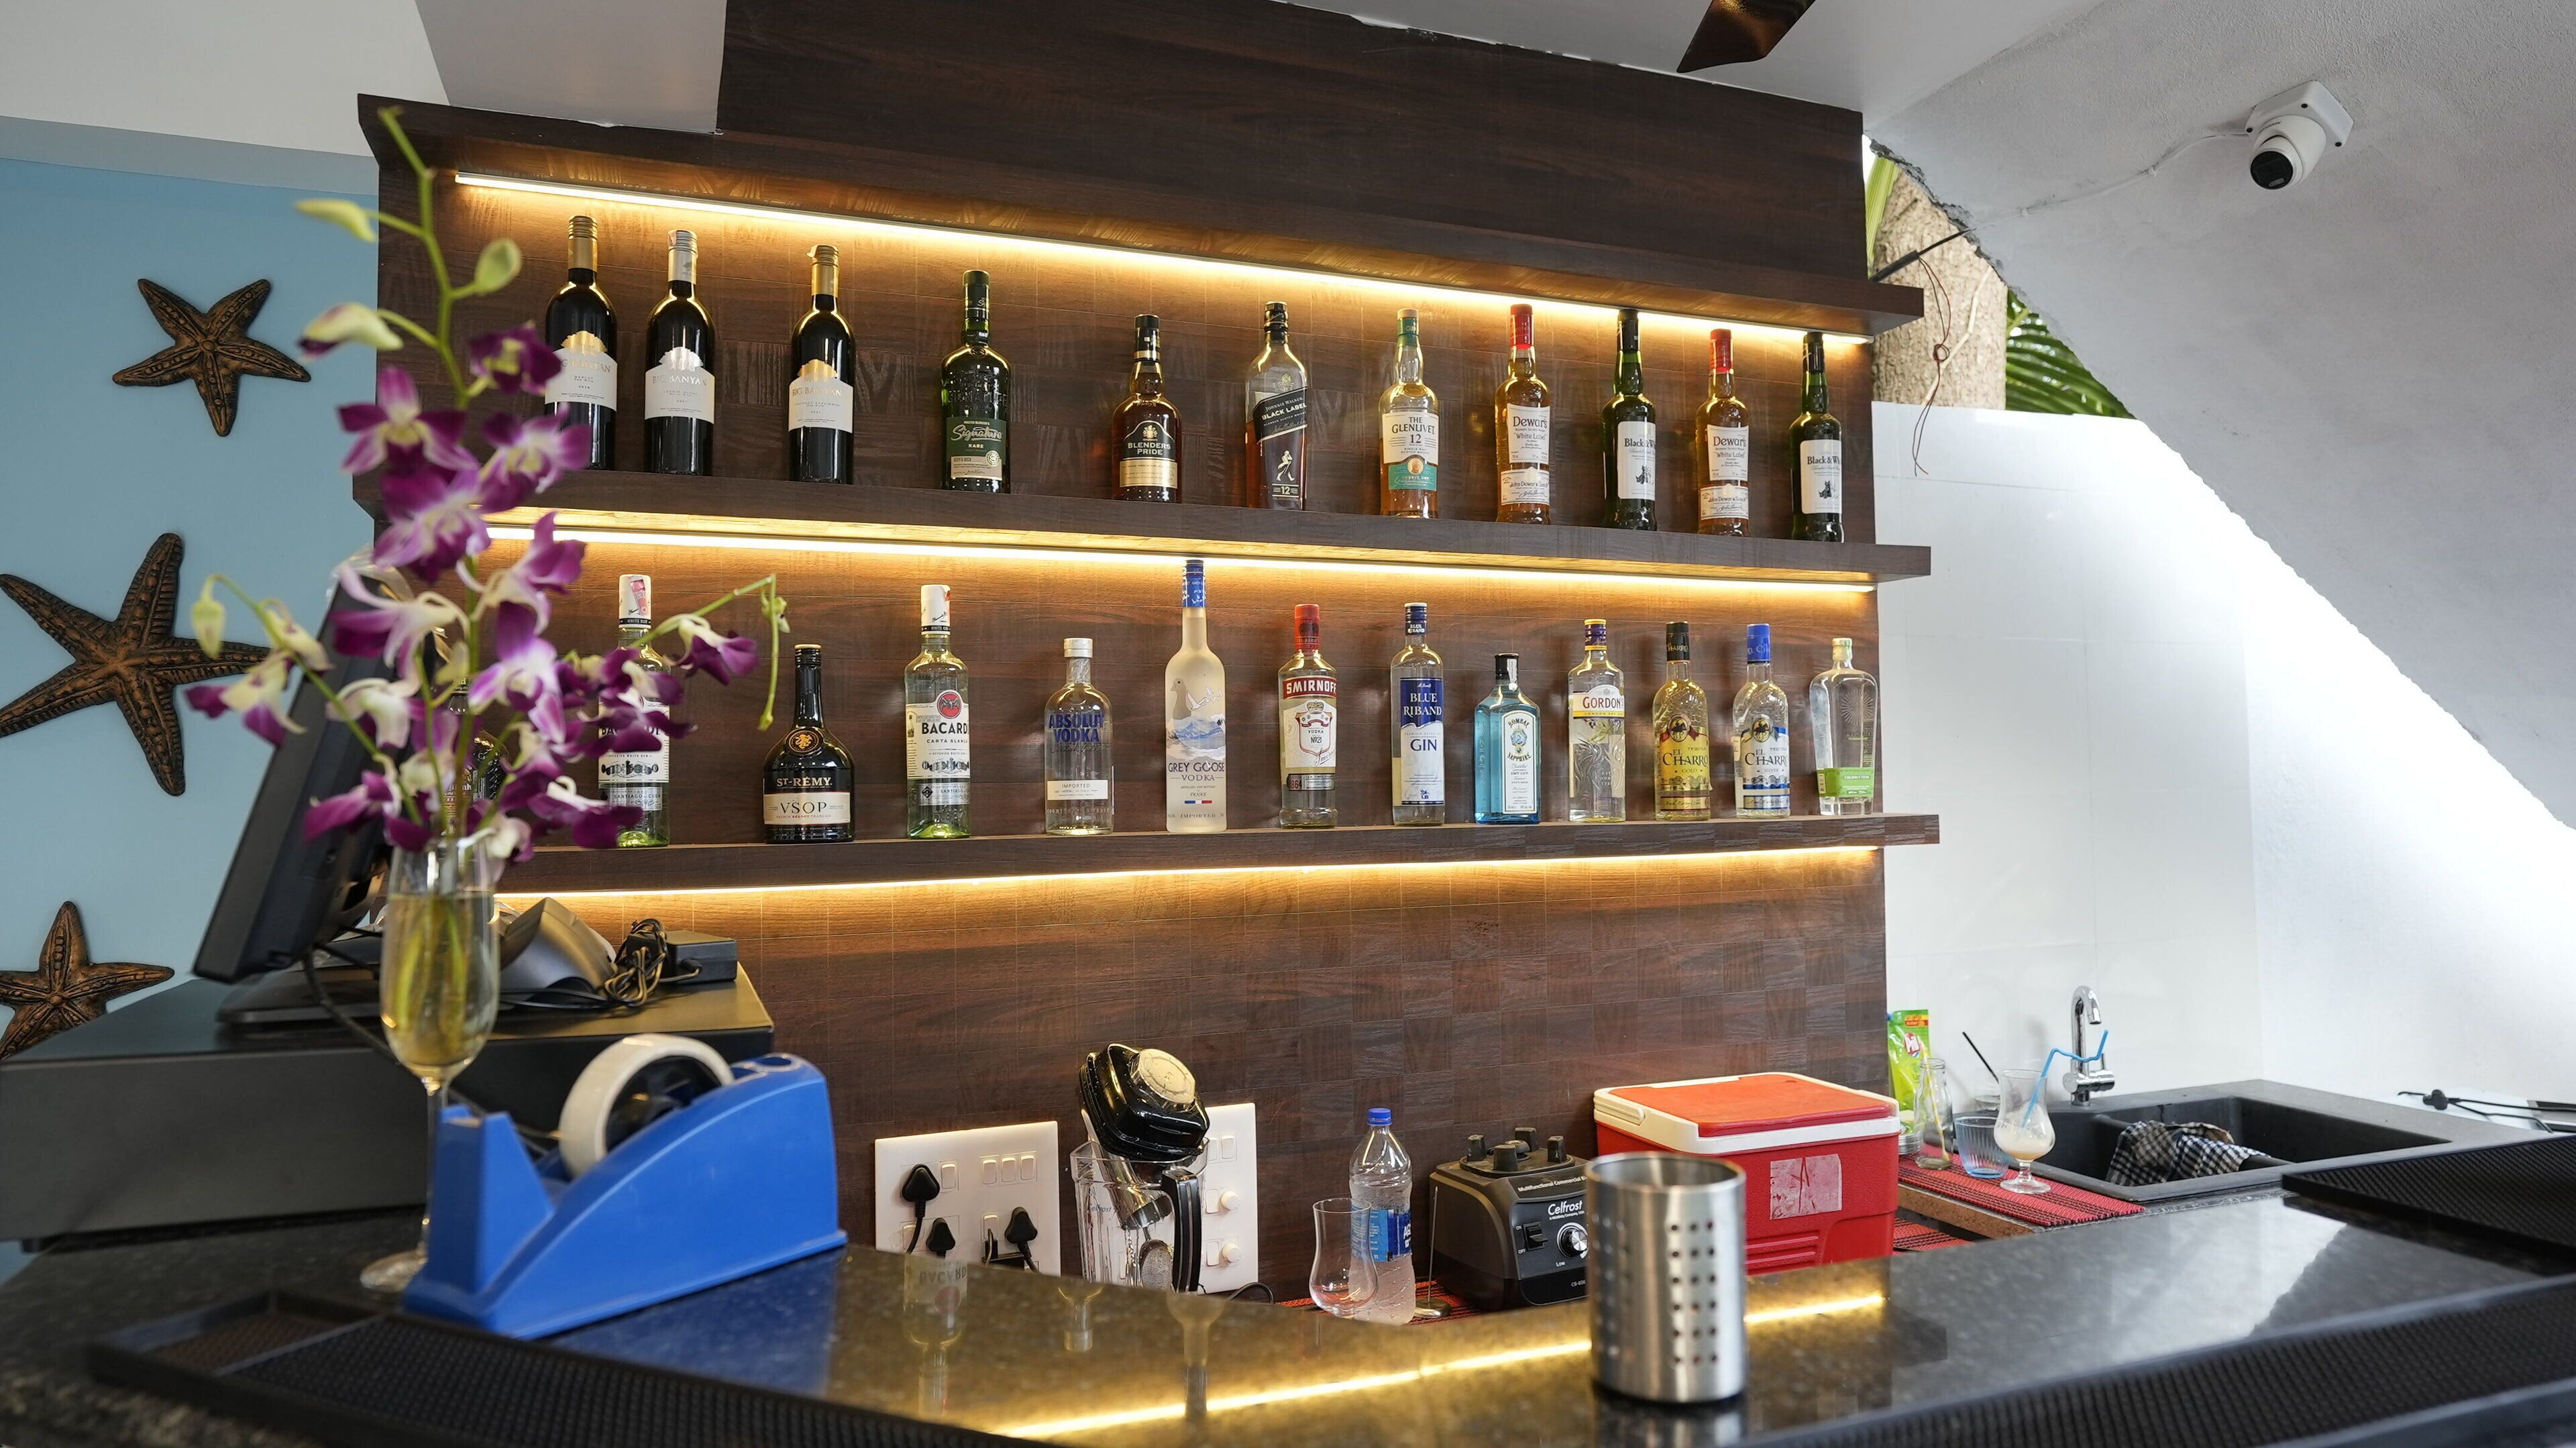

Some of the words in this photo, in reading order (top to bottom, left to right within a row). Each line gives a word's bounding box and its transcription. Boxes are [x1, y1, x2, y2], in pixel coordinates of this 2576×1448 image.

[669, 376, 706, 386] BANYAN
[1261, 408, 1285, 421] BLACK
[1285, 402, 1307, 413] LABEL
[1513, 416, 1548, 429] Dewar's
[951, 424, 1003, 441] Signature
[1391, 424, 1435, 435] GLENLIVET
[1411, 434, 1421, 443] 12
[1624, 438, 1644, 447] Black
[1713, 436, 1746, 447] Dewar's
[1807, 456, 1826, 465] Black
[1281, 486, 1291, 494] 12
[1410, 693, 1438, 702] BLUE
[1403, 706, 1442, 718] RIBAND
[922, 722, 968, 734] BACARD
[1049, 714, 1104, 730] ABSOLUT
[1508, 718, 1529, 728] BOMBAY
[1053, 729, 1099, 742] VODKA
[1410, 738, 1437, 751] GIN
[1507, 751, 1532, 762] SAPPHIRE
[1663, 753, 1709, 767] CHARRO
[1168, 762, 1189, 772] GREY
[1193, 762, 1224, 772] GOOSE
[780, 801, 827, 814] VSOP
[1517, 1181, 1554, 1192] Multifunctional
[1554, 1177, 1581, 1186] Commercial
[1548, 1201, 1582, 1216] Celfrost
